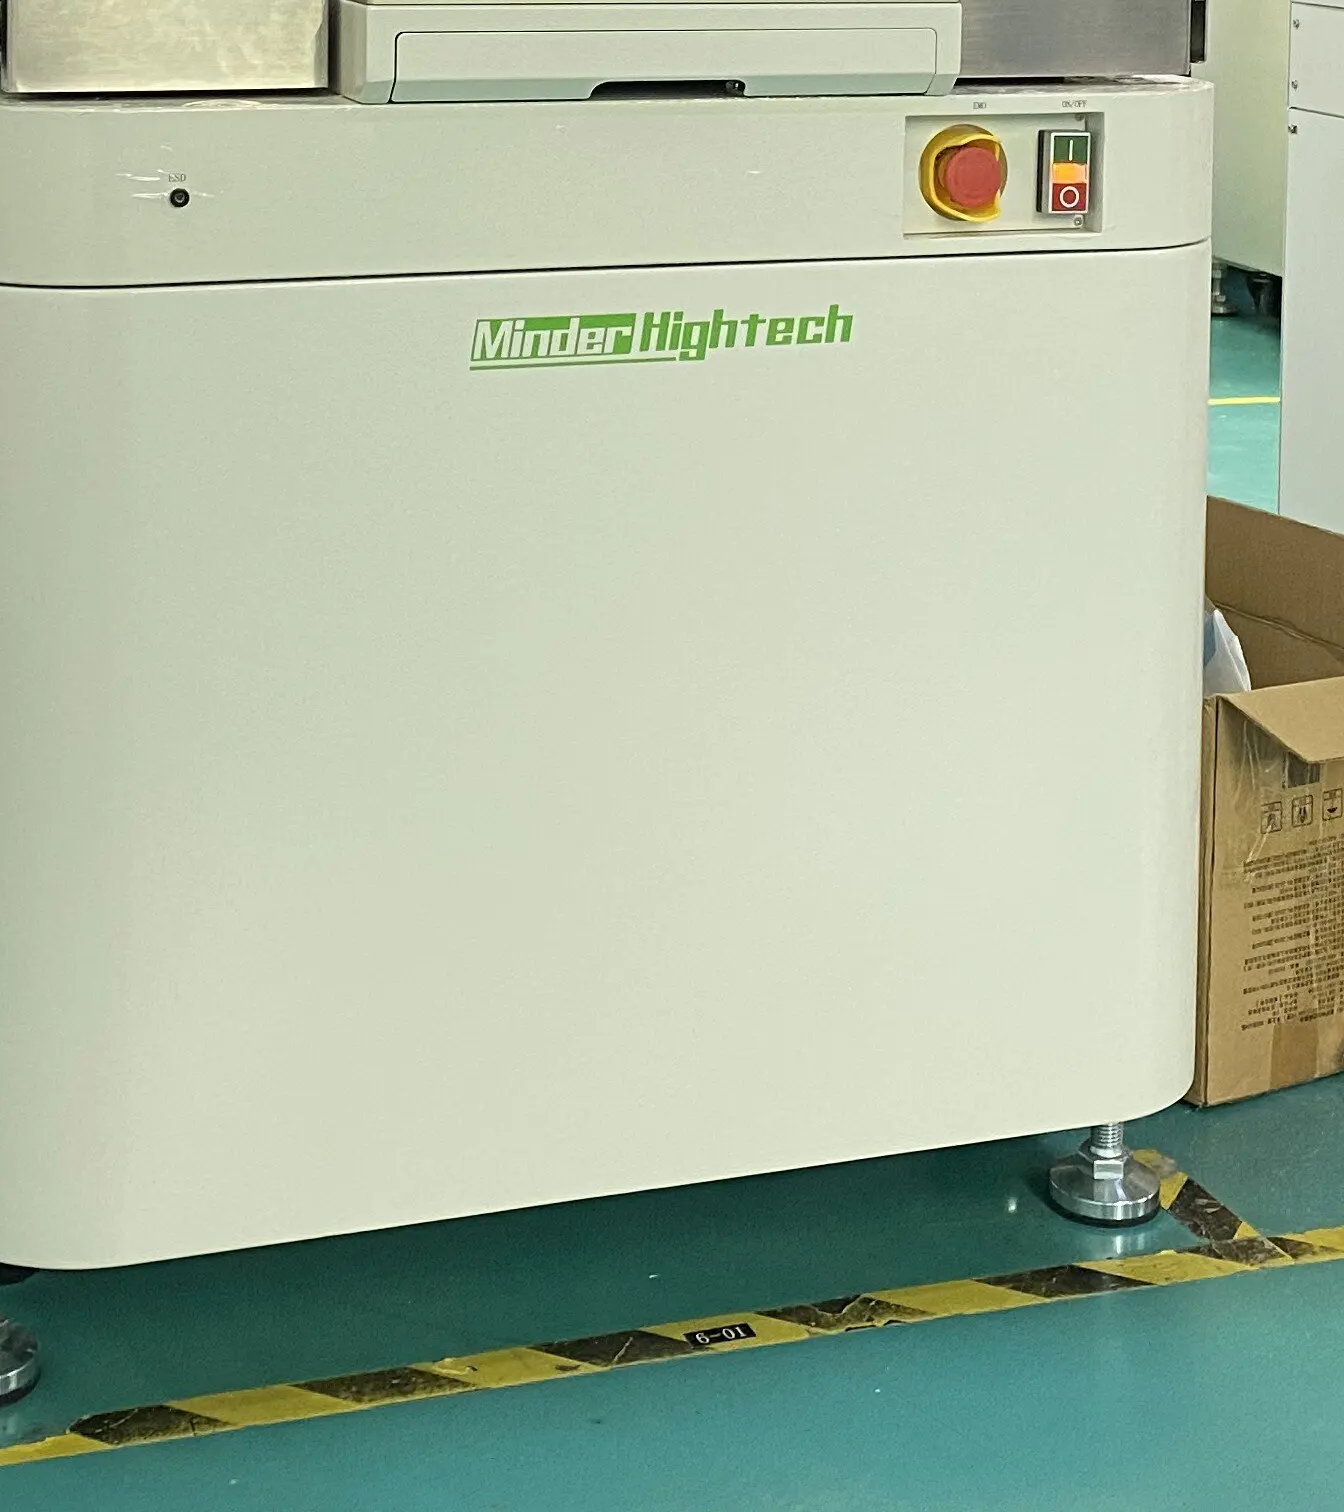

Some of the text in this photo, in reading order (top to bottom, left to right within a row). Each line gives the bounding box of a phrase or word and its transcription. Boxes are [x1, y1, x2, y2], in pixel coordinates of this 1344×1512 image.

[471, 303, 853, 362] Minder Hightech
[695, 1325, 748, 1345] 6-01
